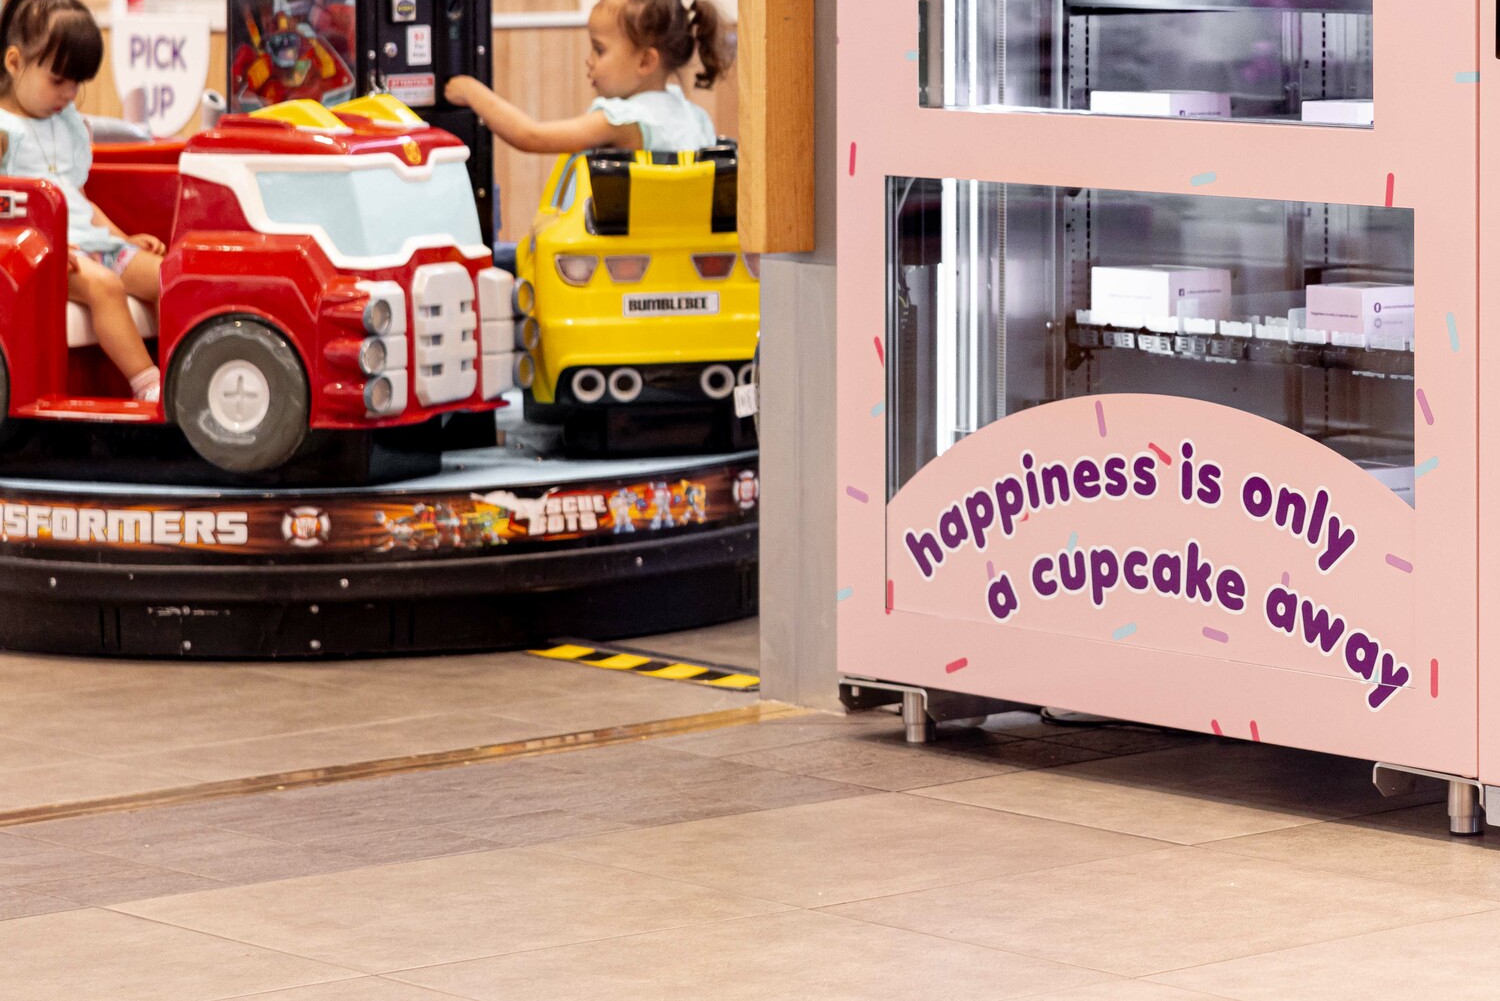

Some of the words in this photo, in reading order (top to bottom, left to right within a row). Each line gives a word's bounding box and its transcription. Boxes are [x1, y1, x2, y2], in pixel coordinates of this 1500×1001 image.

[129, 34, 188, 70] PICK
[145, 85, 176, 118] UP
[628, 297, 707, 311] BUMBLEBEE
[0, 502, 248, 545] SFORMERS
[906, 453, 1156, 577] happiness
[1181, 442, 1221, 504] is
[1242, 476, 1355, 571] only
[988, 575, 1017, 619] a
[1032, 542, 1245, 611] cupcake
[1266, 588, 1410, 708] away
